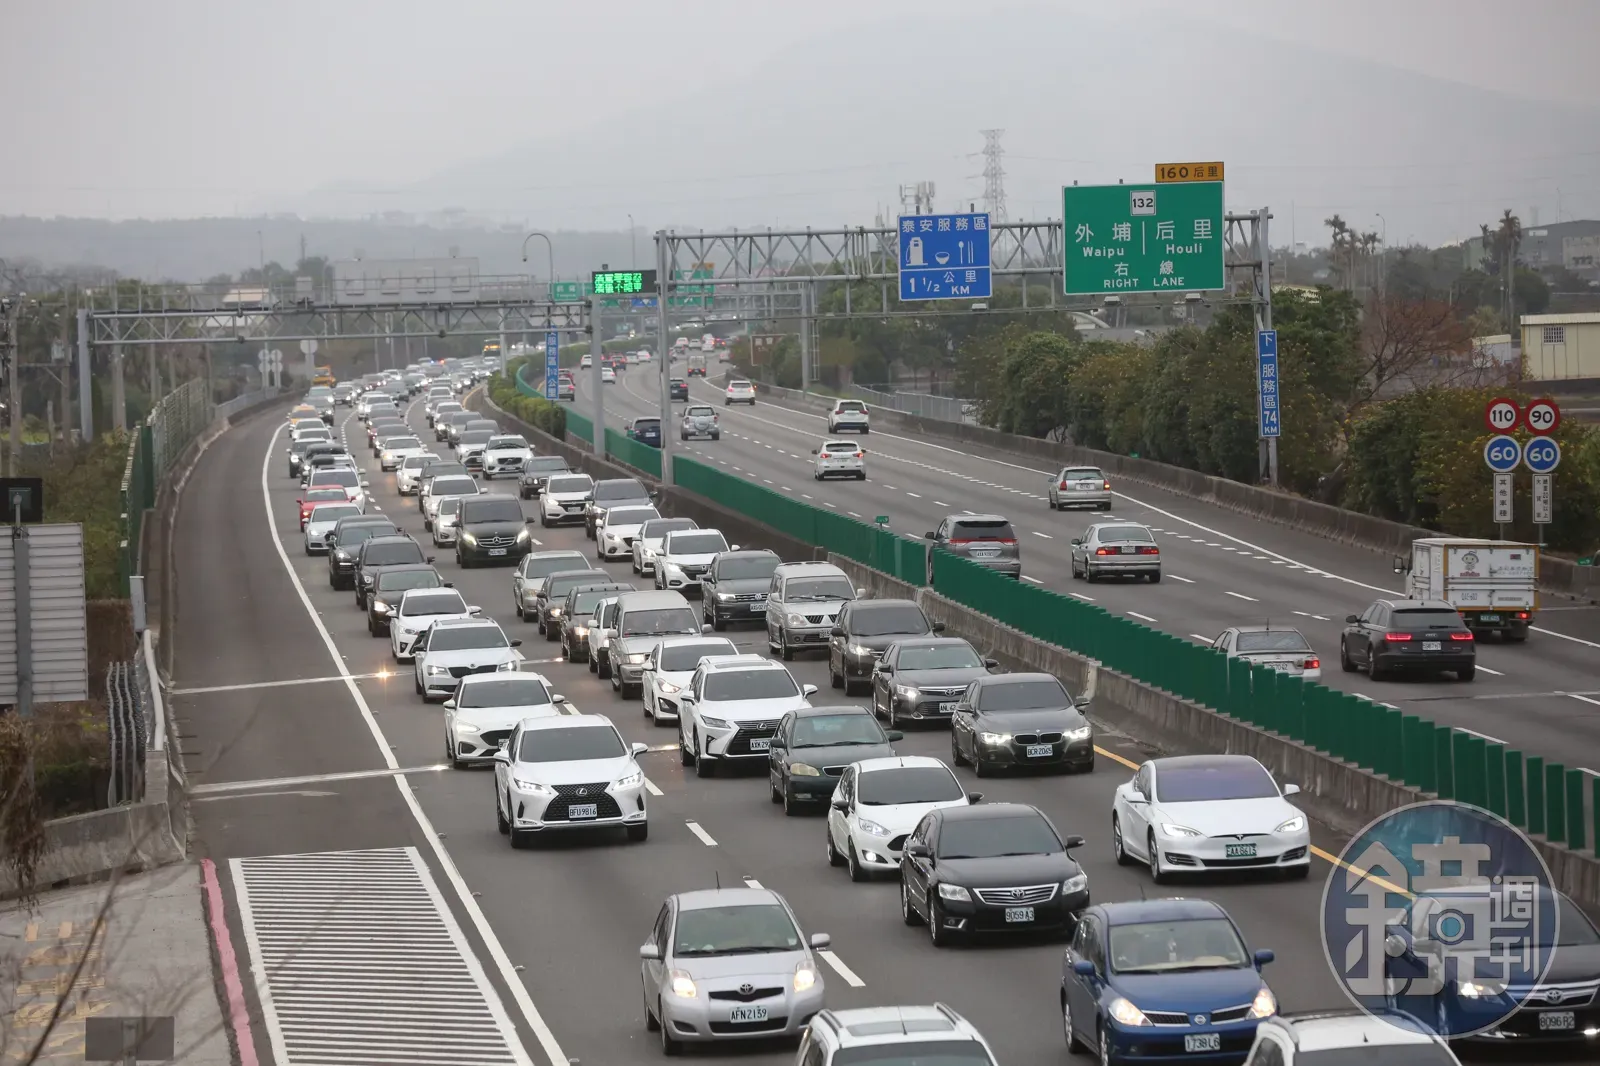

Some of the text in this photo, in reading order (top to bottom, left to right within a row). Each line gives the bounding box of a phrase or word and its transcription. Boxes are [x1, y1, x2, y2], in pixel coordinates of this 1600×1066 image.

[1160, 166, 1218, 178] 160 后里
[1132, 198, 1154, 208] 132
[902, 216, 986, 232] 泰安服務區
[1156, 218, 1212, 240] 后里
[1074, 222, 1132, 243] 外埔
[1082, 247, 1124, 258] Waipu
[1166, 244, 1202, 254] Houli
[944, 270, 976, 282] 公里
[1104, 276, 1184, 288] RIGHT LANE
[910, 278, 916, 292] 1
[952, 286, 970, 294] KM
[1260, 332, 1276, 408] 下一服務區
[1264, 410, 1277, 424] 74
[1492, 410, 1514, 422] 110
[1532, 410, 1552, 423] 90
[1264, 426, 1278, 434] KM
[1490, 447, 1515, 461] 60
[1530, 448, 1554, 462] 60
[1499, 479, 1508, 517] 其他車種
